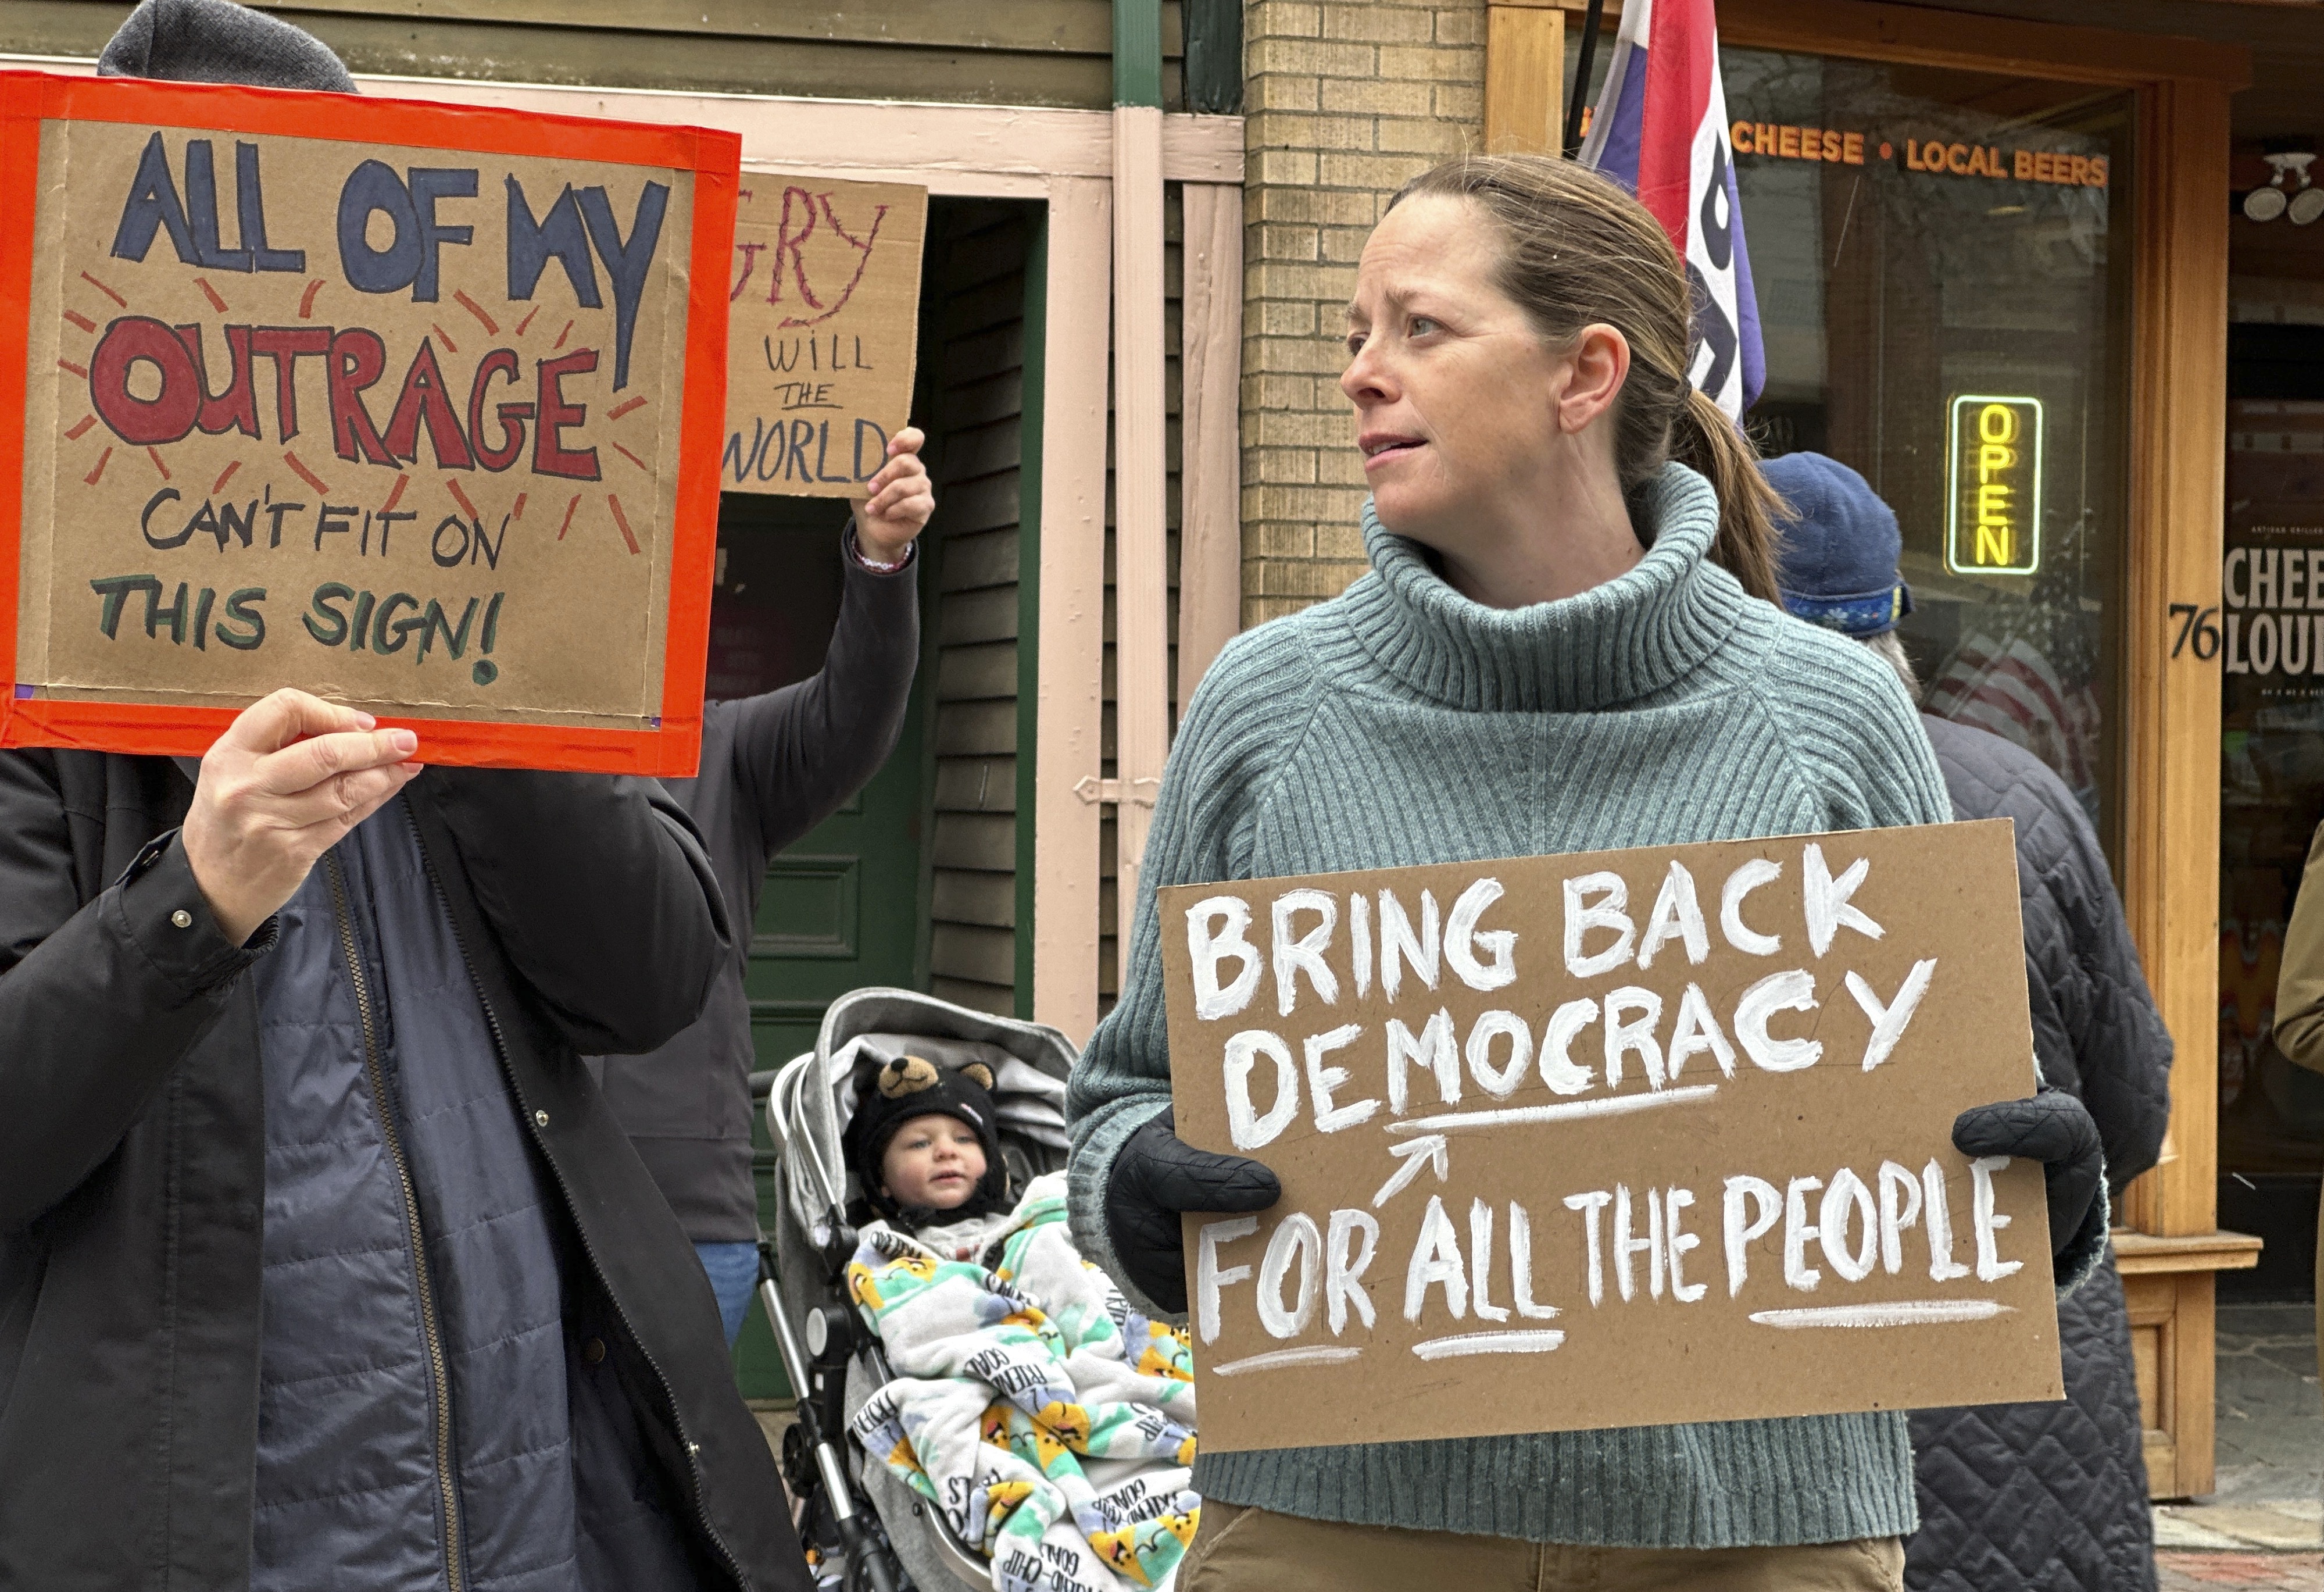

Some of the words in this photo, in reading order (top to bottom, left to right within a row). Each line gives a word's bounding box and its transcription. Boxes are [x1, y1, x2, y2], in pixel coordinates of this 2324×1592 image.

[1729, 120, 1865, 165] CHEESE
[1906, 138, 2008, 179] LOCAL
[2014, 150, 2109, 188] BEERS
[110, 131, 305, 272] ALL
[337, 159, 478, 302] OF
[503, 173, 670, 393] MY
[89, 316, 601, 481] OUTRAGE
[774, 382, 835, 405] THE
[141, 484, 306, 552] CAN'T
[314, 505, 416, 557] FIT
[432, 513, 510, 571] ON
[1976, 404, 2012, 565] OPEN
[90, 574, 268, 653] THIS
[302, 581, 506, 686] SIGN!
[2169, 604, 2221, 661] 76
[2224, 547, 2324, 609] CHEE
[1185, 876, 1519, 1021] BRING
[1562, 842, 1886, 979] BACK
[1222, 956, 1938, 1151] DEMOCRACY
[1198, 1207, 1380, 1344] FOR
[1403, 1194, 1564, 1322] ALL
[1562, 1181, 1709, 1305] THE
[1724, 1155, 2025, 1302] PEOPLE
